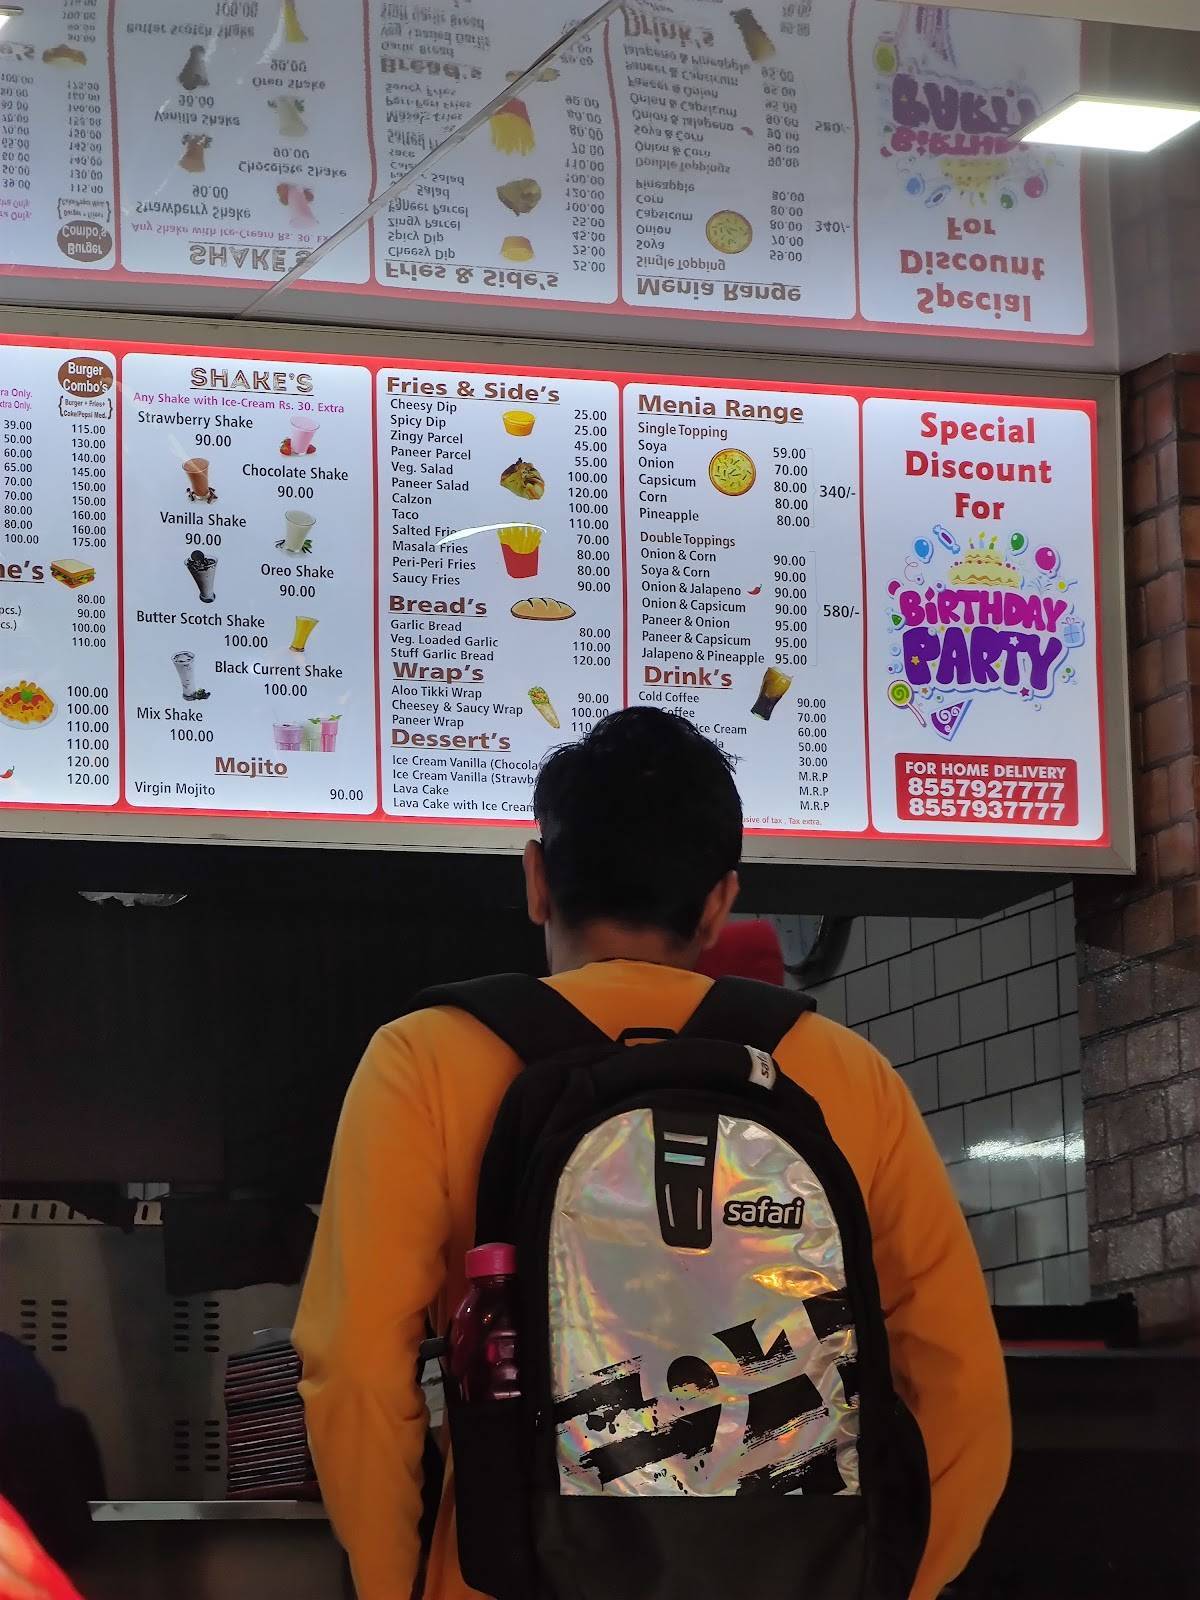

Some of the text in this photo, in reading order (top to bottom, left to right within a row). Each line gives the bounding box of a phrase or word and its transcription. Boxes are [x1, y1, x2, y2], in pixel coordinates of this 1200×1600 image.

[68, 362, 103, 377] Burger
[63, 379, 108, 393] Combo's
[190, 368, 313, 393] SHAKE'S
[12, 389, 32, 399] Only.
[387, 377, 560, 402] Fries & Side's
[133, 392, 344, 413] Any Shake with Ice-Cream Rs. 30. Extra
[390, 399, 457, 414] Cheesy Dip
[638, 394, 804, 424] Menia Range
[138, 411, 253, 429] Strawberry Shake
[390, 414, 446, 429] Spicy Dip
[574, 409, 607, 421] 25.00
[4, 420, 32, 430] 39.00
[72, 424, 106, 434] 115.00
[638, 422, 728, 441] Single Topping
[920, 412, 1035, 446] Special
[195, 433, 232, 447] 90.00
[390, 430, 463, 444] Zingy Parcel
[391, 446, 471, 460] Paneer Parcel
[638, 441, 667, 454] Soya
[773, 448, 806, 460] 59.00
[391, 462, 453, 475] Veg. Salad
[638, 457, 674, 469] Onion
[905, 450, 1053, 484] Discount
[72, 468, 106, 477] 145.00
[242, 464, 349, 481] Chocolate Shake
[638, 474, 696, 488] Capsicum
[277, 486, 314, 500] 90.00
[392, 493, 432, 505] Calzon
[568, 488, 608, 499] 120.00
[819, 486, 856, 499] 340/-
[955, 493, 1005, 520] For
[160, 511, 247, 527] Vanilla Shake
[392, 509, 419, 520] Taco
[639, 508, 699, 523] Pineapple
[777, 516, 810, 527] 80.00
[392, 525, 431, 537] Salted
[72, 537, 106, 548] 175.00
[640, 532, 736, 549] Double Toppings
[641, 549, 716, 562] Onion & Corn
[773, 555, 806, 566] 90.00
[392, 557, 476, 570] Peri-Peri Fries
[261, 563, 334, 579] Oreo Shake
[392, 572, 460, 586] Saucy Fries
[577, 581, 611, 593] 90.00
[642, 581, 741, 597] Onion & Jalapeno
[77, 594, 105, 605] 80.00
[389, 595, 487, 615] Bread's
[823, 605, 860, 618] 580/-
[137, 610, 265, 628] Butter Scotch Shake
[390, 619, 462, 632] Garlic Bread
[390, 634, 499, 647] Veg. Loaded Garlic
[579, 628, 611, 639] 80.00
[224, 634, 268, 648] 100.00
[572, 656, 611, 667] 120.00
[642, 648, 765, 665] Jalapeno & Pineapple
[903, 626, 1063, 691] PARTY
[215, 661, 343, 678] Black Current Shake
[393, 662, 484, 684] Wrap's
[644, 665, 733, 687] Drink's
[67, 686, 109, 698] 100.00
[391, 686, 482, 699] Aloo Tikki Wrap
[578, 693, 609, 704] 90.00
[638, 691, 700, 703] Cold Coffee
[137, 707, 203, 722] Mix Shake
[392, 700, 523, 716] Cheesey & Saucy Wrap
[391, 729, 511, 749] Dessert's
[215, 756, 288, 777] Mojito
[392, 756, 487, 768] Ice Cream Vanilla
[799, 757, 828, 767] 30.00
[799, 772, 828, 782] M.R.P
[905, 761, 1066, 779] FOR HOME DELIVERY
[67, 773, 110, 785] 120.00
[135, 781, 215, 797] Virgin Mojito
[330, 788, 364, 801] 90.00
[908, 779, 1064, 799] 8557927777
[393, 799, 498, 811] Lava Cake with Ice
[909, 799, 1065, 820] 8557937777
[728, 1201, 803, 1225] safari
